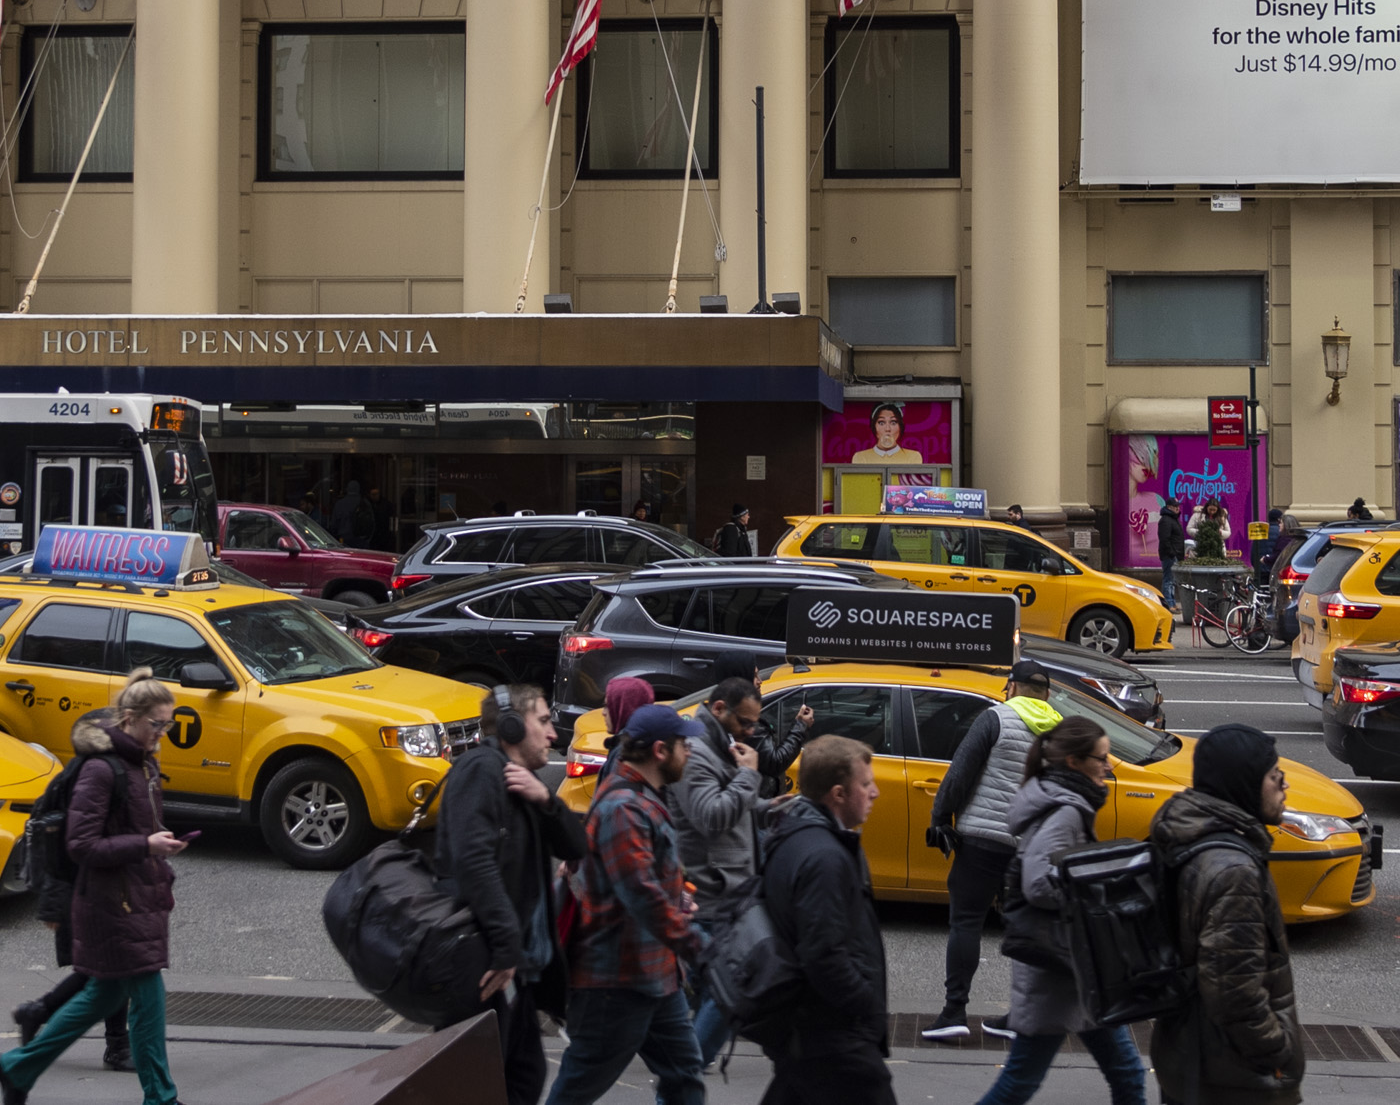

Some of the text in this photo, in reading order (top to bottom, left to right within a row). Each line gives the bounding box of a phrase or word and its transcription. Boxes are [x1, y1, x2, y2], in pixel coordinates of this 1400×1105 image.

[1212, 27, 1241, 45] for
[1246, 27, 1281, 45] the
[1286, 26, 1350, 44] whole
[1234, 53, 1397, 75] Just $14.99/mo
[42, 329, 440, 354] HOTEL PENNSYLVANIA
[49, 402, 91, 416] 4204
[1169, 457, 1236, 505] Candytopia
[954, 500, 983, 510] OPEN
[955, 492, 982, 502] NOW
[51, 529, 170, 575] WAITRESS
[1018, 588, 1032, 605] T
[847, 608, 993, 630] SQUARESPACE
[807, 636, 992, 652] DOMAINS WEBSITES ONLINE STORES
[174, 714, 195, 744] T
